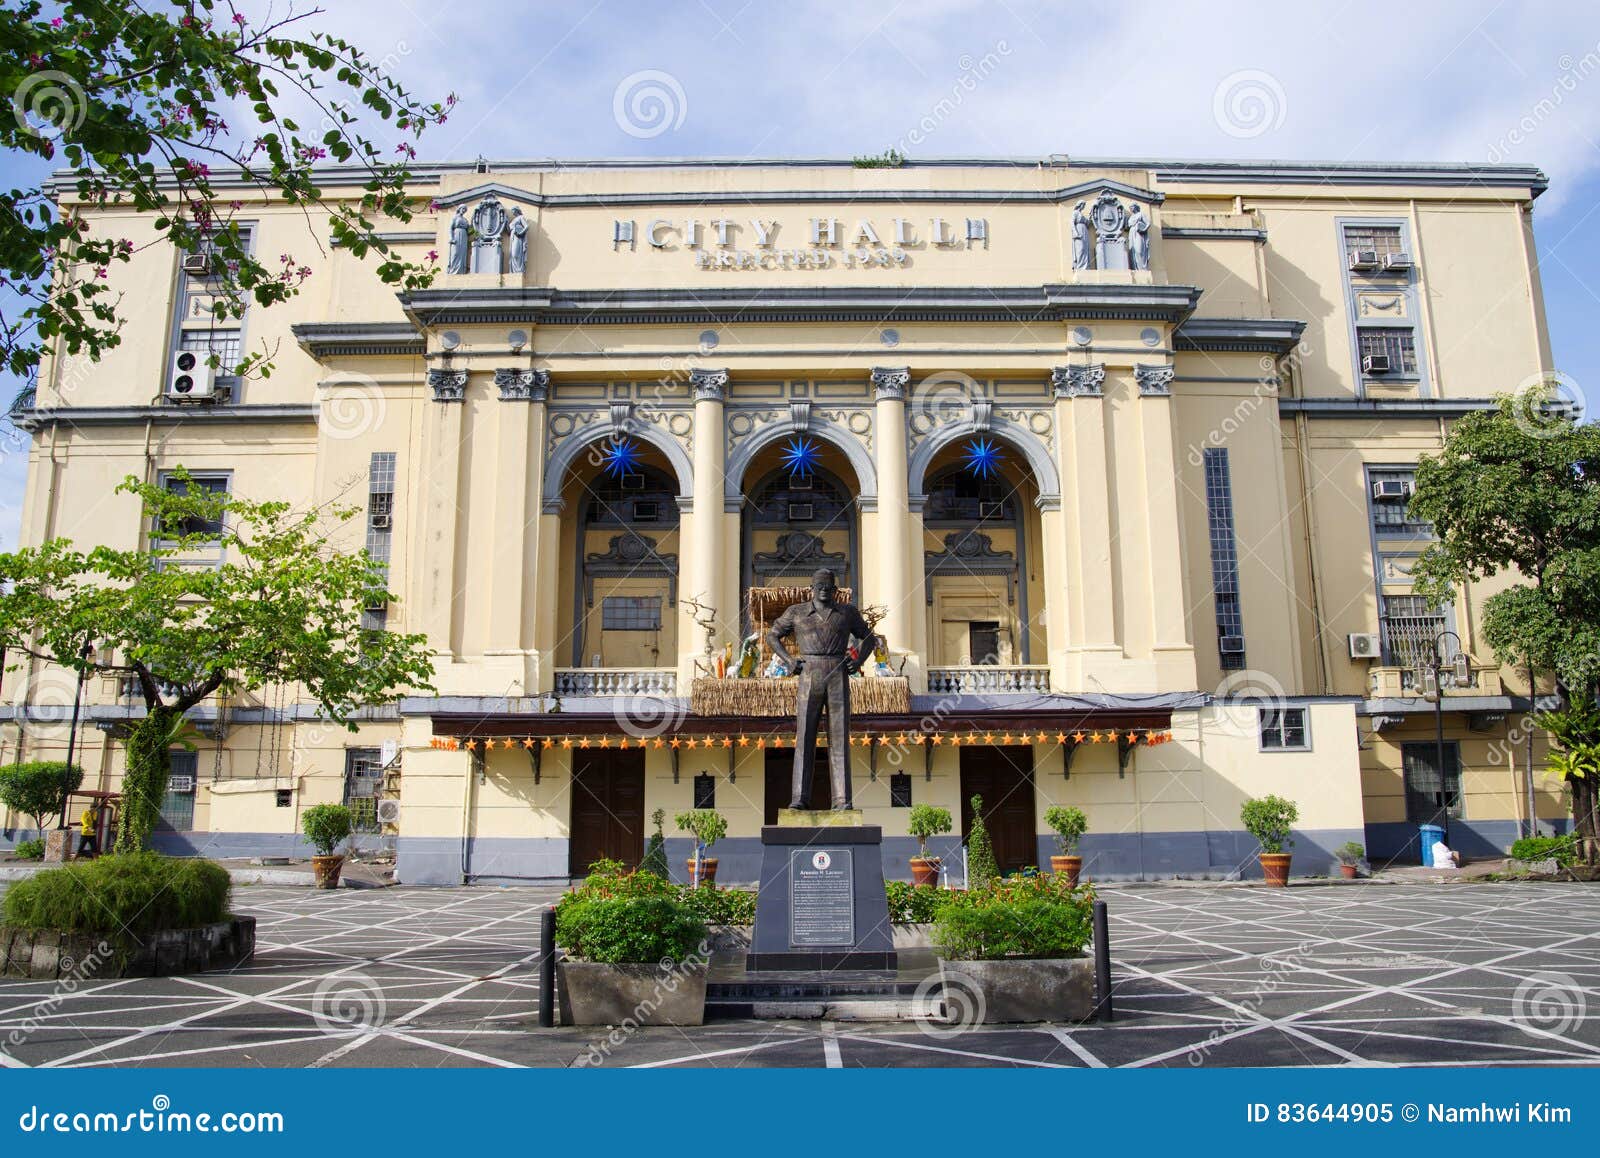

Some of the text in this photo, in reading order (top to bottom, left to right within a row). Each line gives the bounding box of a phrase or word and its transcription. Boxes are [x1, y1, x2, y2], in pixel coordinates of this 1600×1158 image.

[647, 217, 957, 248] CITY HALL
[695, 248, 907, 267] ERECTED 1939
